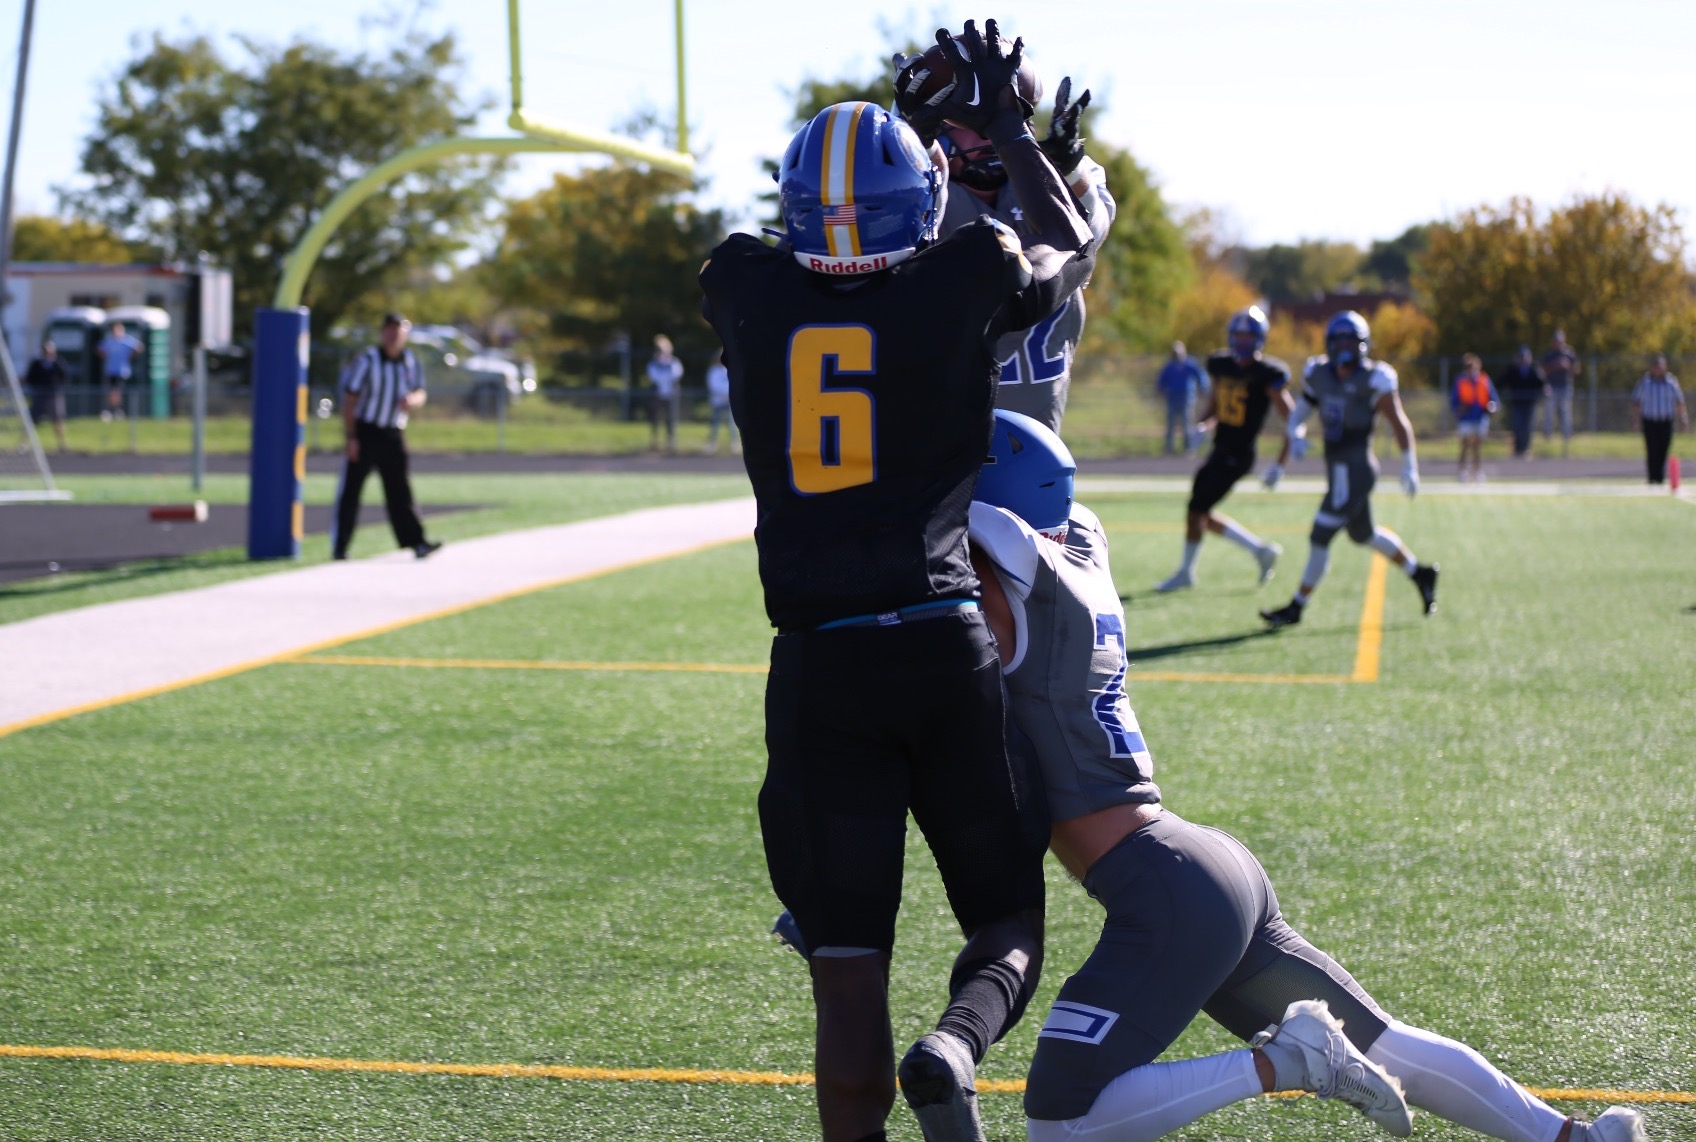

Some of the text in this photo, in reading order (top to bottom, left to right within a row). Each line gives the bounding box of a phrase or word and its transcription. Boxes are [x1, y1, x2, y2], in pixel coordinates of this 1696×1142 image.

[809, 256, 888, 274] Riddell
[997, 297, 1070, 384] 2
[786, 322, 877, 496] 6
